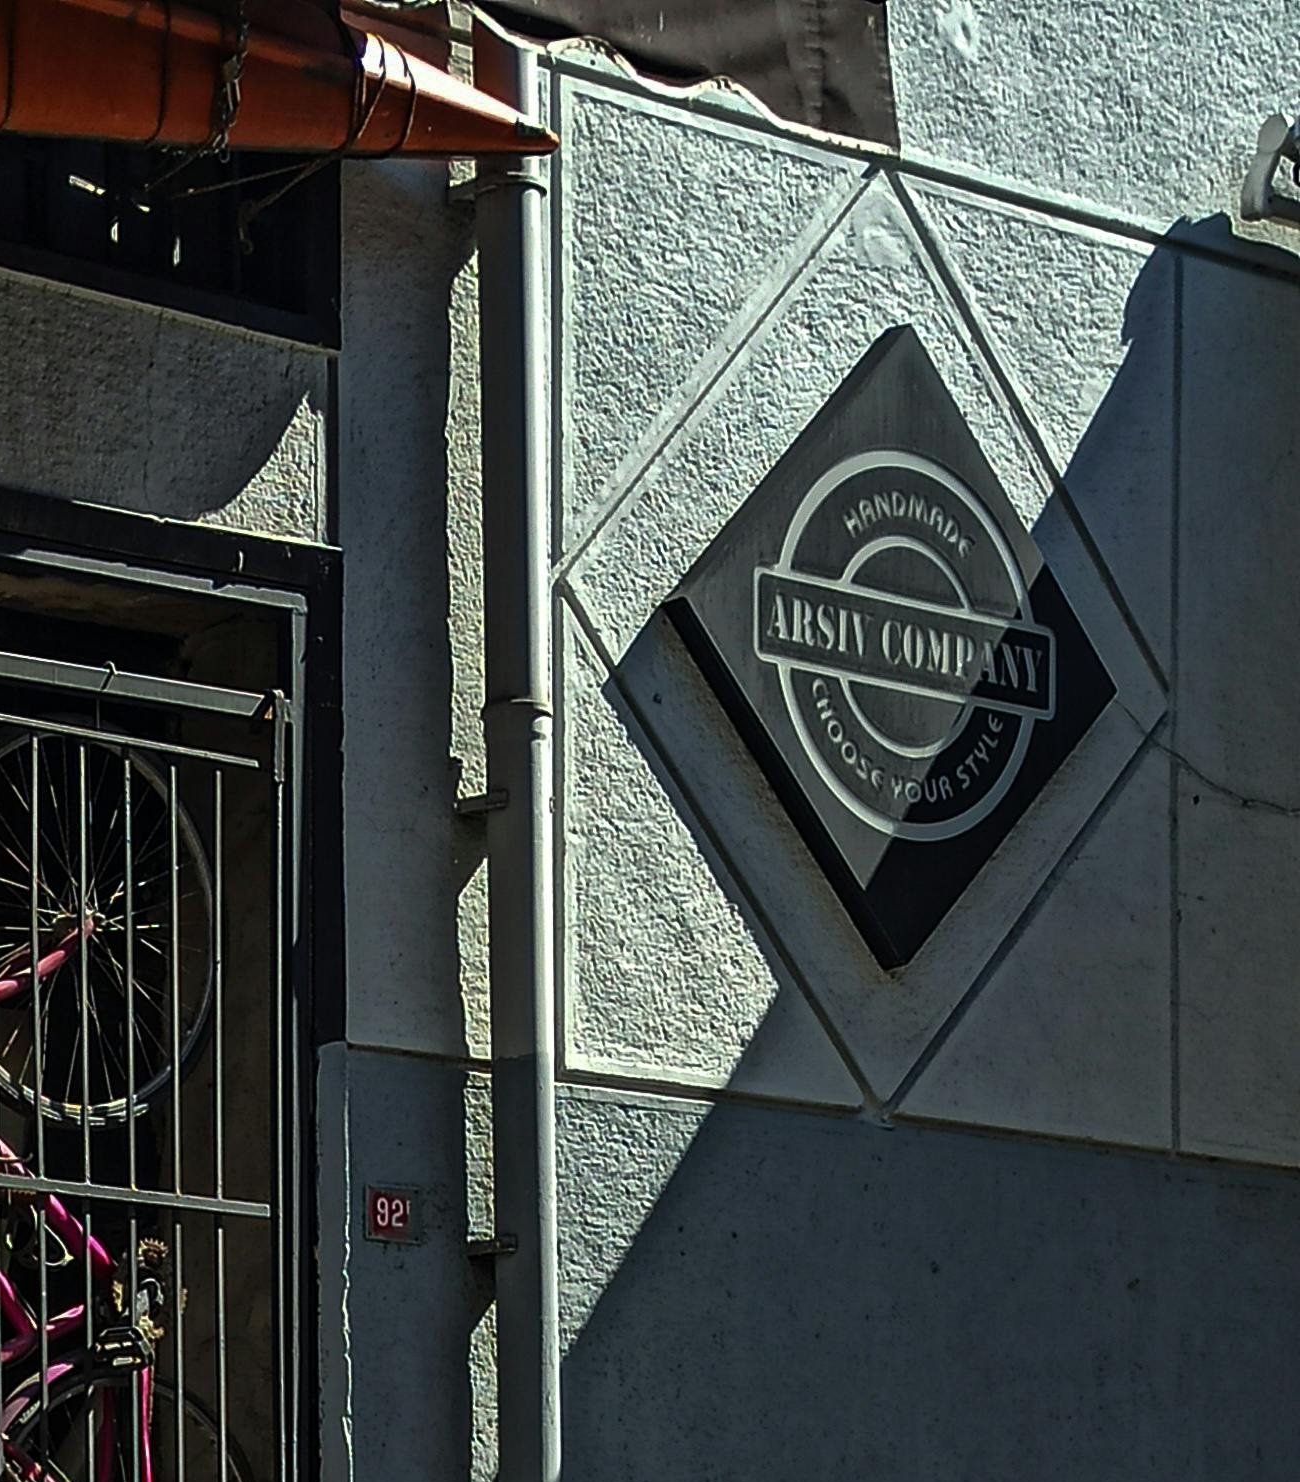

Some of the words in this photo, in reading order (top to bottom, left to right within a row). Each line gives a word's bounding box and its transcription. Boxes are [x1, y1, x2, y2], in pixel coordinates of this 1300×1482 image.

[842, 489, 972, 558] HANDMADE
[767, 591, 873, 657] ARSIV
[881, 619, 1043, 694] COMPANY
[812, 677, 885, 790] CHOOSE
[890, 774, 954, 803] YOUR
[955, 713, 1004, 790] STYLE
